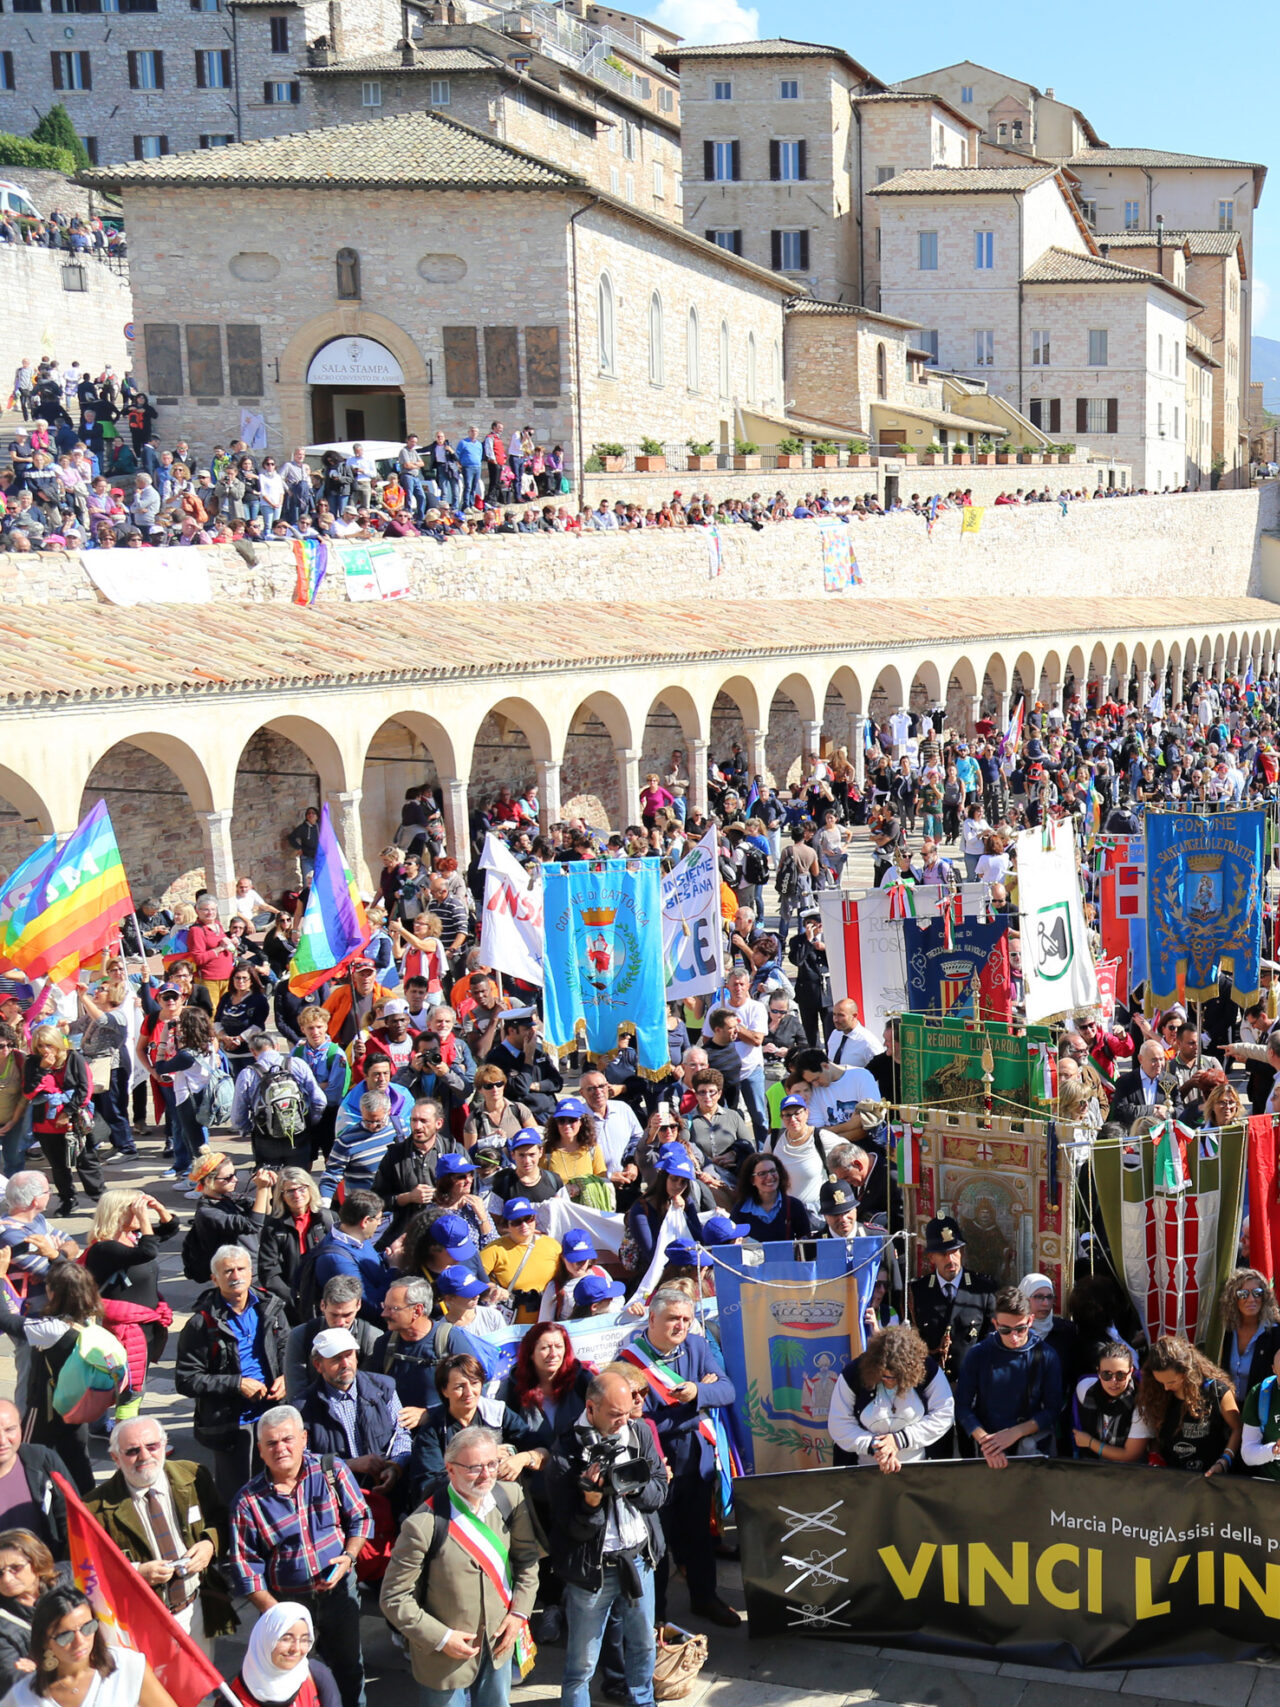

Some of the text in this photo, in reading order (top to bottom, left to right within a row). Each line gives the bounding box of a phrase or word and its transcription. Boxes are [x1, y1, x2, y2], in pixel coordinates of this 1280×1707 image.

[321, 365, 390, 373] SALA STAMPA
[1174, 817, 1237, 832] COMUNE
[663, 858, 713, 894] INSIEME
[601, 888, 650, 928] CATTOLICA
[927, 1033, 963, 1049] REGIONE
[601, 1332, 624, 1341] FONDI
[1050, 1509, 1107, 1534] Marcia
[1111, 1517, 1215, 1547] PerugiAssisi
[1219, 1523, 1262, 1546] della
[877, 1541, 1103, 1615] VINCI
